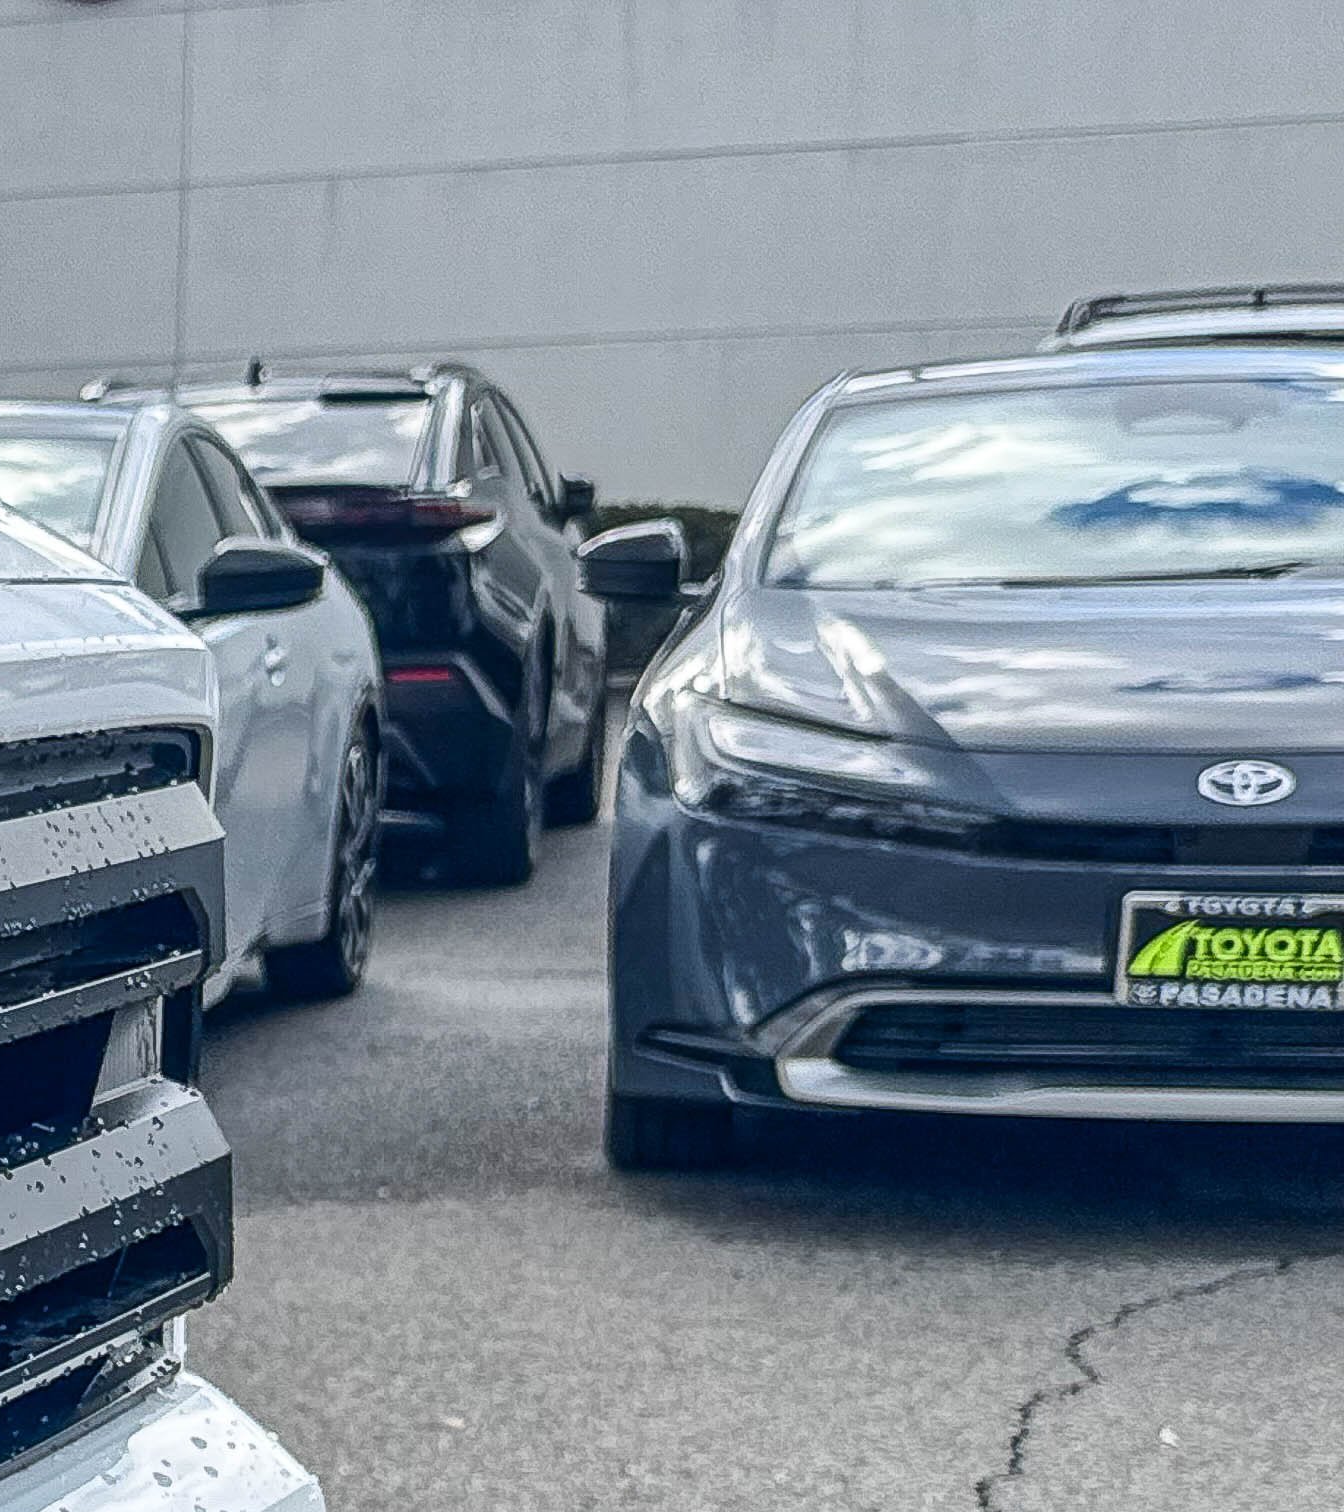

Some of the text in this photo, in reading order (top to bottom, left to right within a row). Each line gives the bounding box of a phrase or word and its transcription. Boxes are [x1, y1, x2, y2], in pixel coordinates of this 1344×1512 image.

[1188, 897, 1296, 915] TOYOTA
[1190, 928, 1343, 960] TOYOTA
[1160, 984, 1332, 1008] PASADENA
